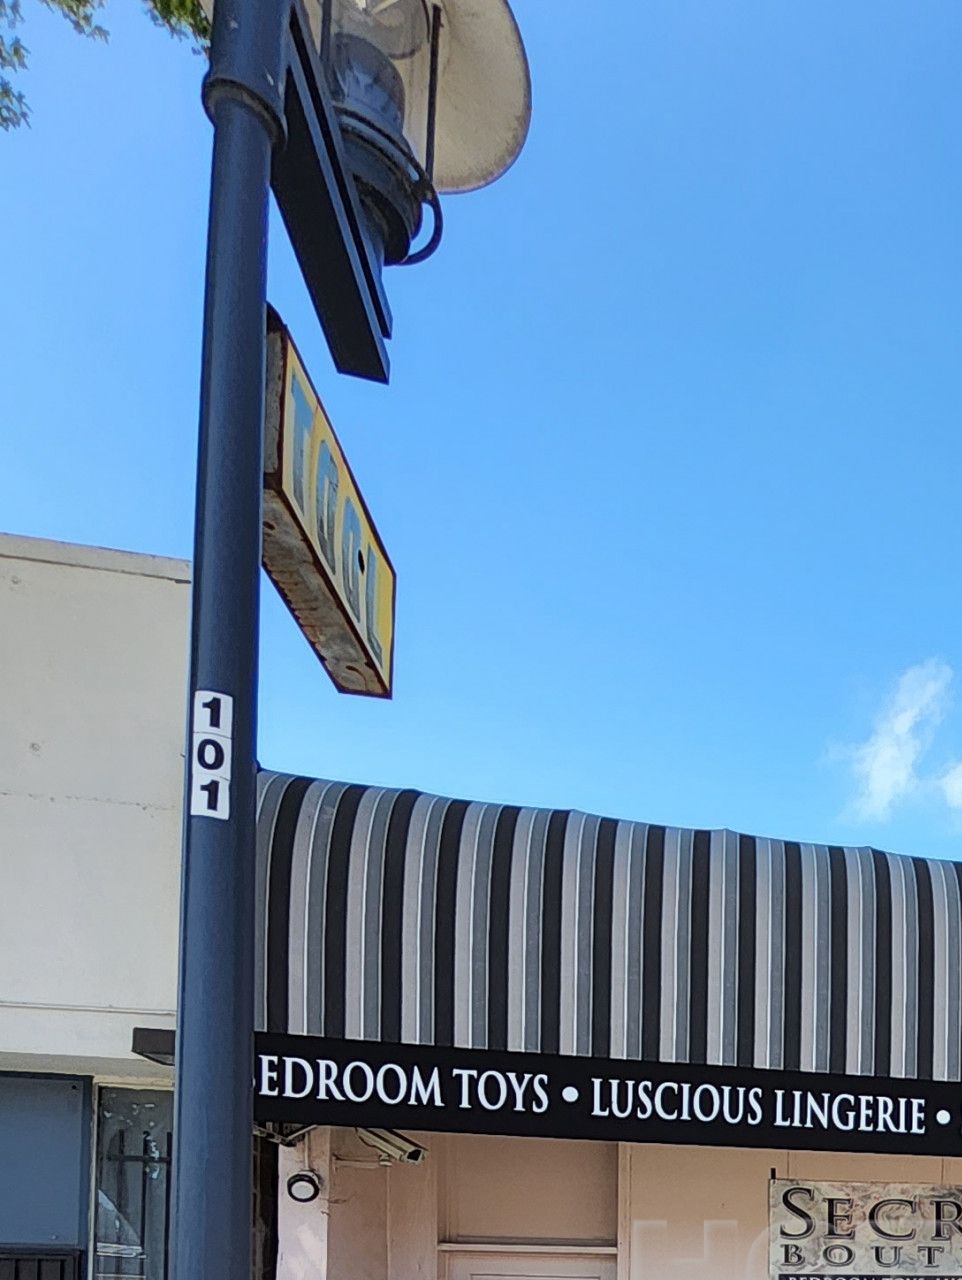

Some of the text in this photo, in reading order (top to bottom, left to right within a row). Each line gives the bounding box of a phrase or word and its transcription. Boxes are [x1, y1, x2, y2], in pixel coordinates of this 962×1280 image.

[197, 697, 225, 811] 101
[252, 1054, 444, 1107] EDROOM
[452, 1068, 549, 1113] TOYS
[591, 1077, 762, 1126] LUSCIOUS
[774, 1089, 926, 1135] LINGERIE
